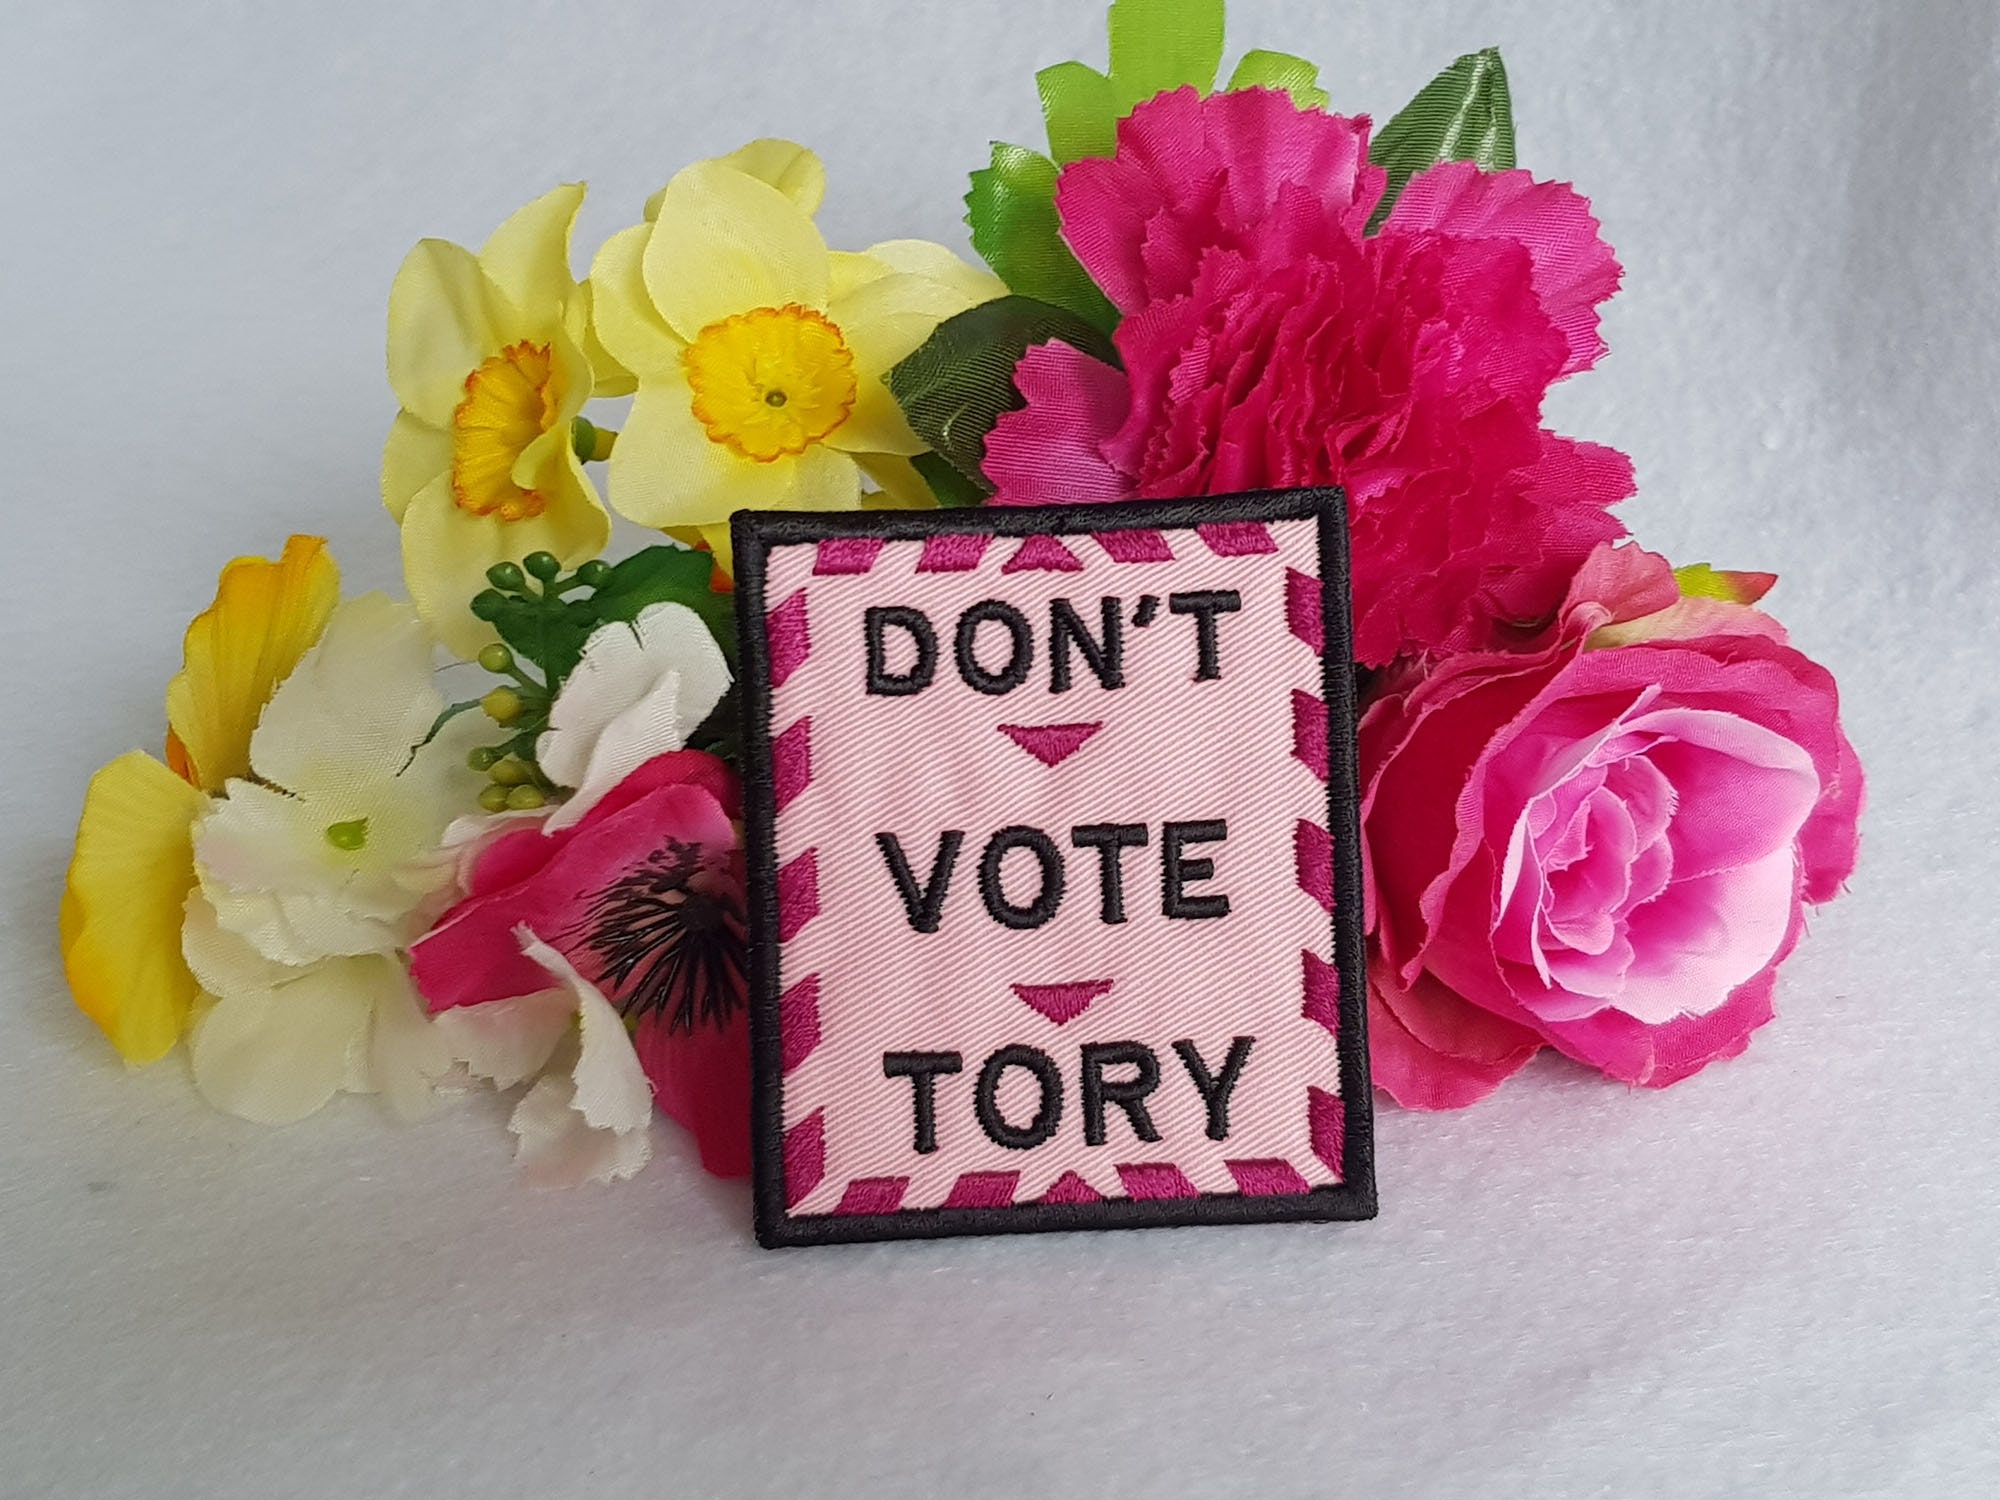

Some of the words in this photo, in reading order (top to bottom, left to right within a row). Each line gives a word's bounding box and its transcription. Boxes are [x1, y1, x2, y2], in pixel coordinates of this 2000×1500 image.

[864, 589, 1242, 698] DON'T
[875, 818, 1233, 935] VOTE
[883, 1035, 1257, 1156] TORY
